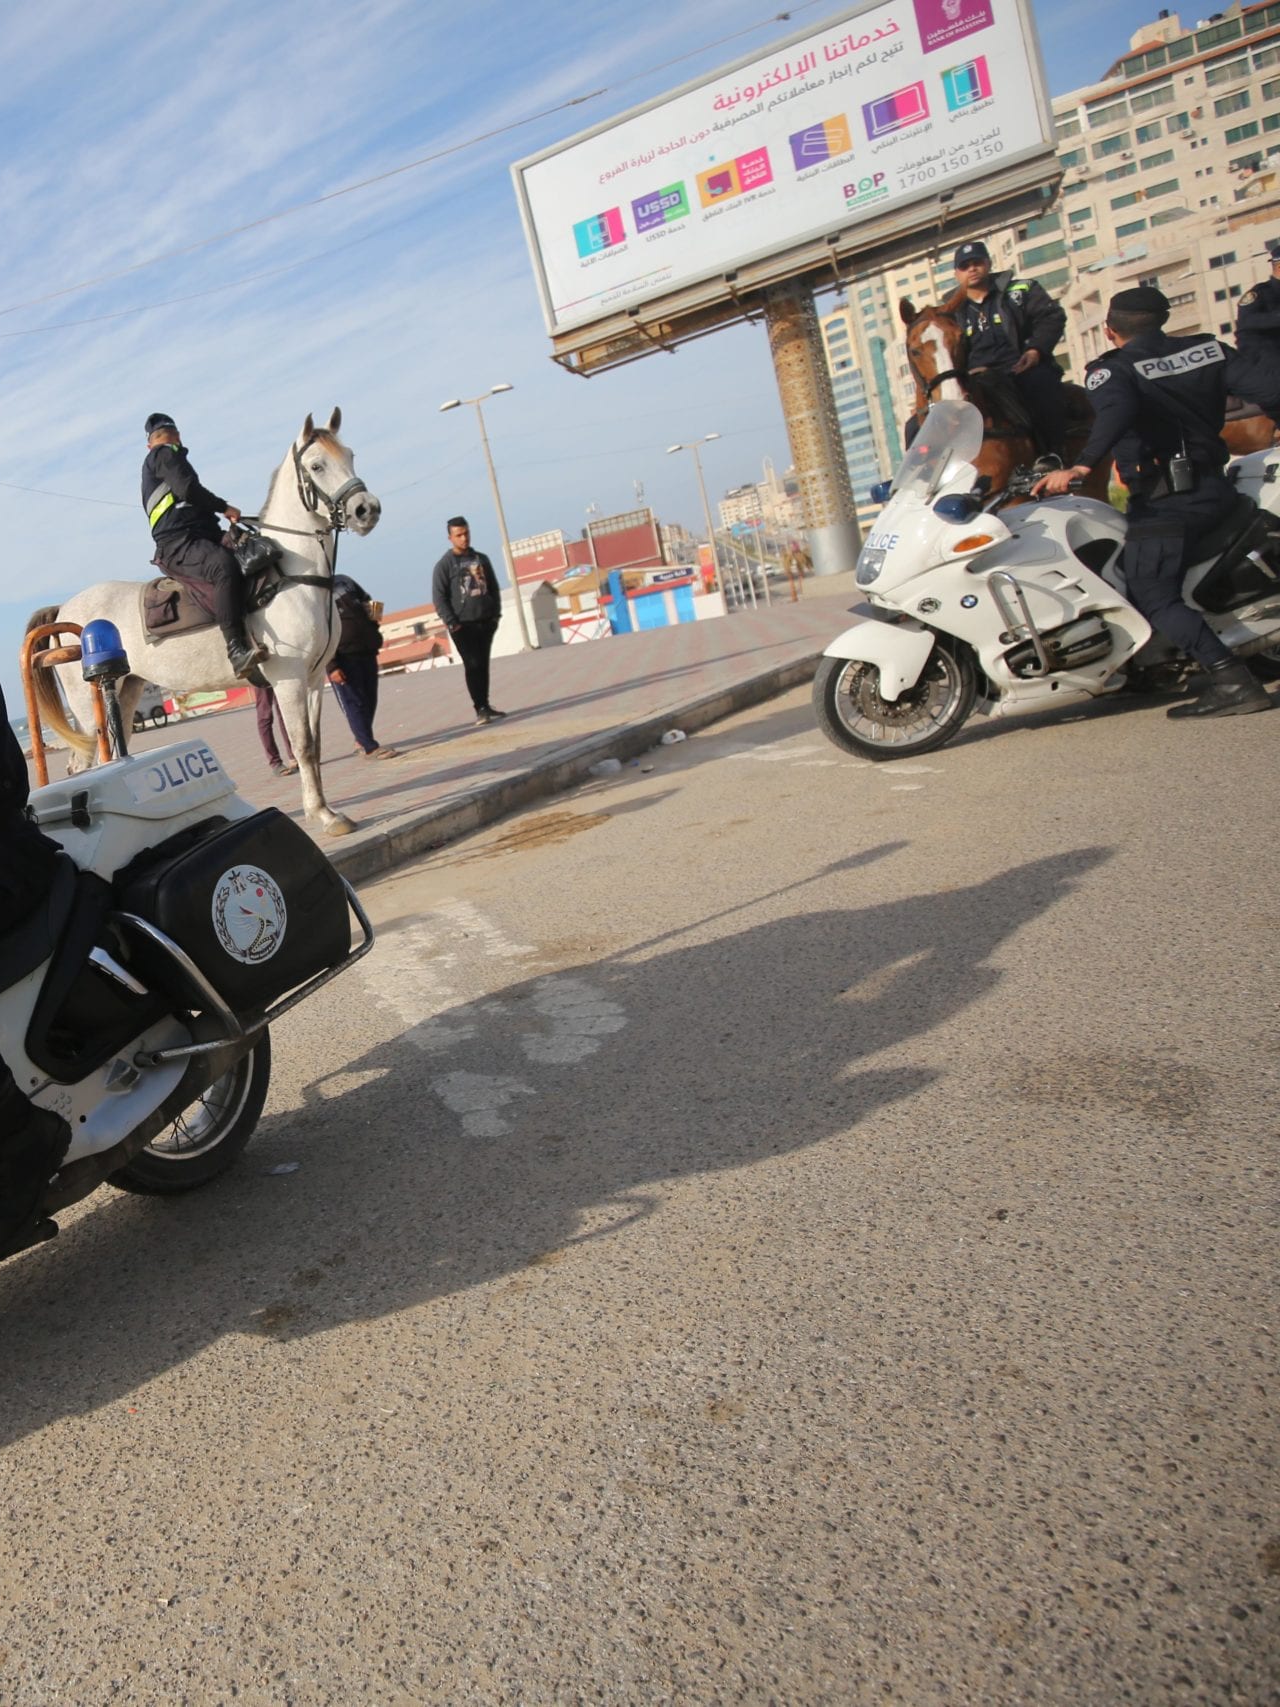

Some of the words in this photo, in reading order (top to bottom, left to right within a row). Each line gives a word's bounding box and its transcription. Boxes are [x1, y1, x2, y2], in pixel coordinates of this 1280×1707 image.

[824, 18, 900, 62] خدماتنا
[880, 41, 904, 62] تتيح
[828, 64, 852, 84] إنجاز
[856, 53, 877, 74] لكم
[713, 52, 816, 110] الإلكترونية
[767, 78, 825, 112] معاملاتكم
[712, 102, 764, 132] المصرفية
[658, 136, 687, 155] الحاجة
[690, 128, 710, 144] دون
[968, 127, 1000, 148] للمزيد
[896, 148, 946, 174] المعلومات
[948, 144, 965, 156] من
[598, 161, 628, 184] الفروع
[900, 167, 936, 190] 1700
[942, 154, 969, 172] 150
[976, 141, 1004, 160] 150
[844, 172, 884, 198] BOP
[638, 192, 680, 218] USSD
[1142, 346, 1218, 376] POLICE
[145, 748, 218, 793] OLICE
